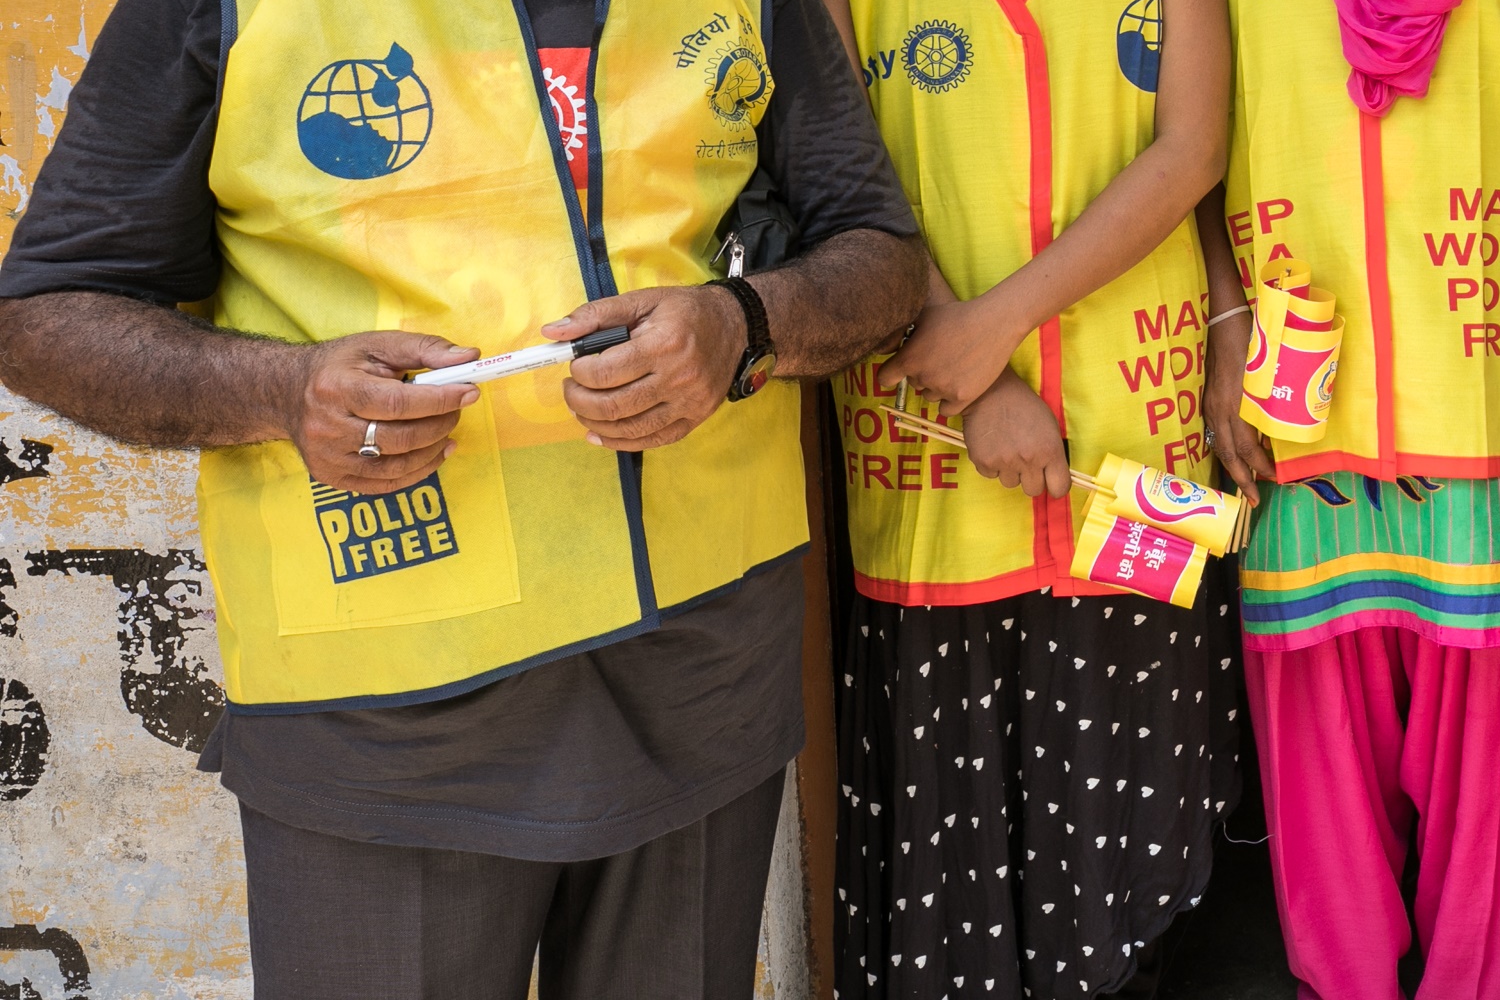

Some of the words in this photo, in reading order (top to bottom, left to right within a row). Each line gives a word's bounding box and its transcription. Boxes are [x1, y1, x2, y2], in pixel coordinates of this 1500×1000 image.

[672, 12, 731, 69] पोलियो
[847, 450, 960, 491] FREE
[320, 485, 443, 579] POLIO
[348, 521, 455, 574] FREE
[1116, 558, 1135, 581] की
